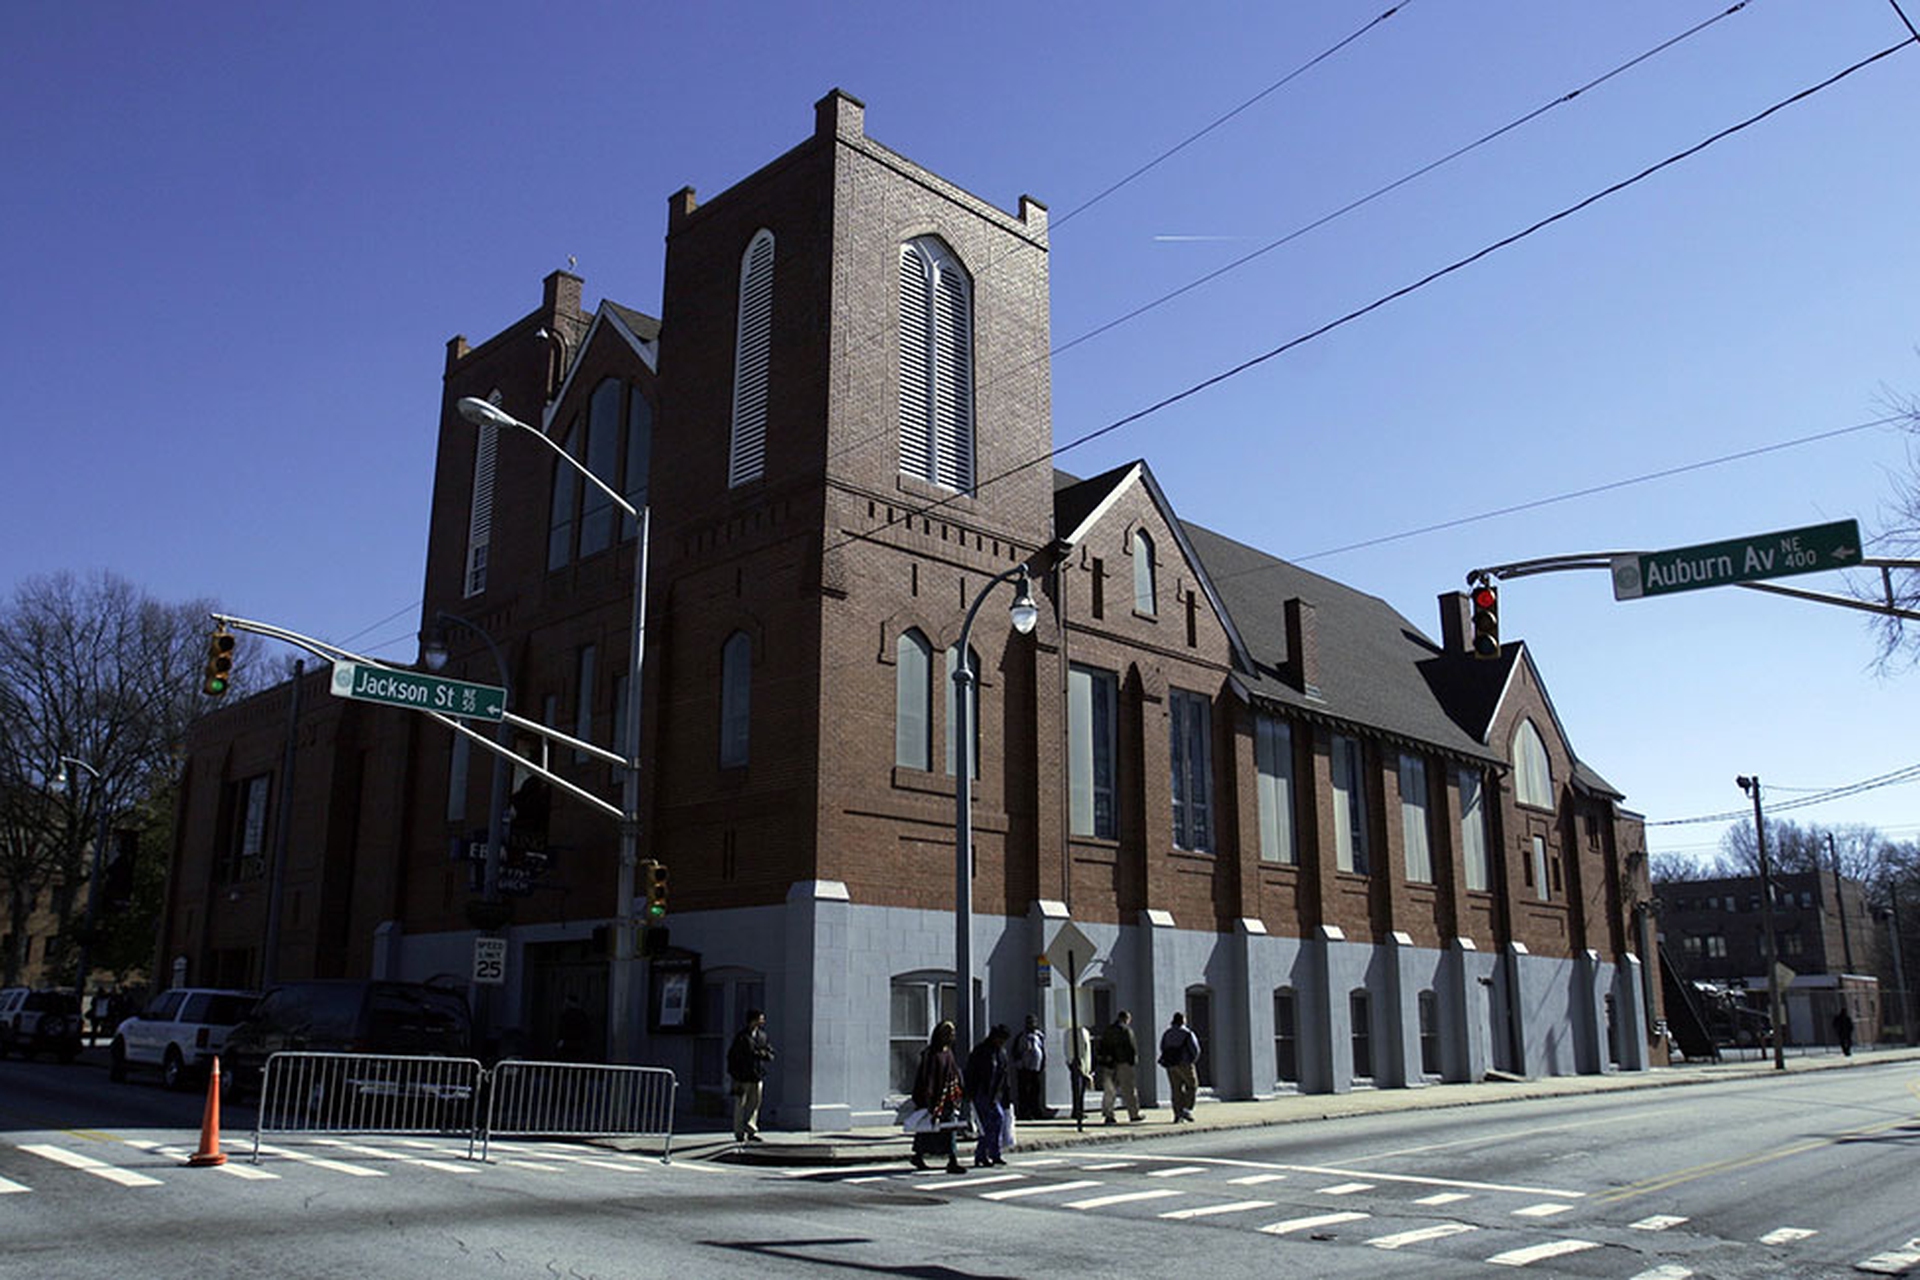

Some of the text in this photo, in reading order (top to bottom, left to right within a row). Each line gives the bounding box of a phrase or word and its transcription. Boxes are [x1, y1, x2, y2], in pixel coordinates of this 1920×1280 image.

[1781, 536, 1799, 552] NE
[1646, 545, 1775, 588] Auburn Av
[1784, 550, 1817, 568] 400
[356, 672, 455, 707] Jackson St
[477, 960, 501, 979] 25
